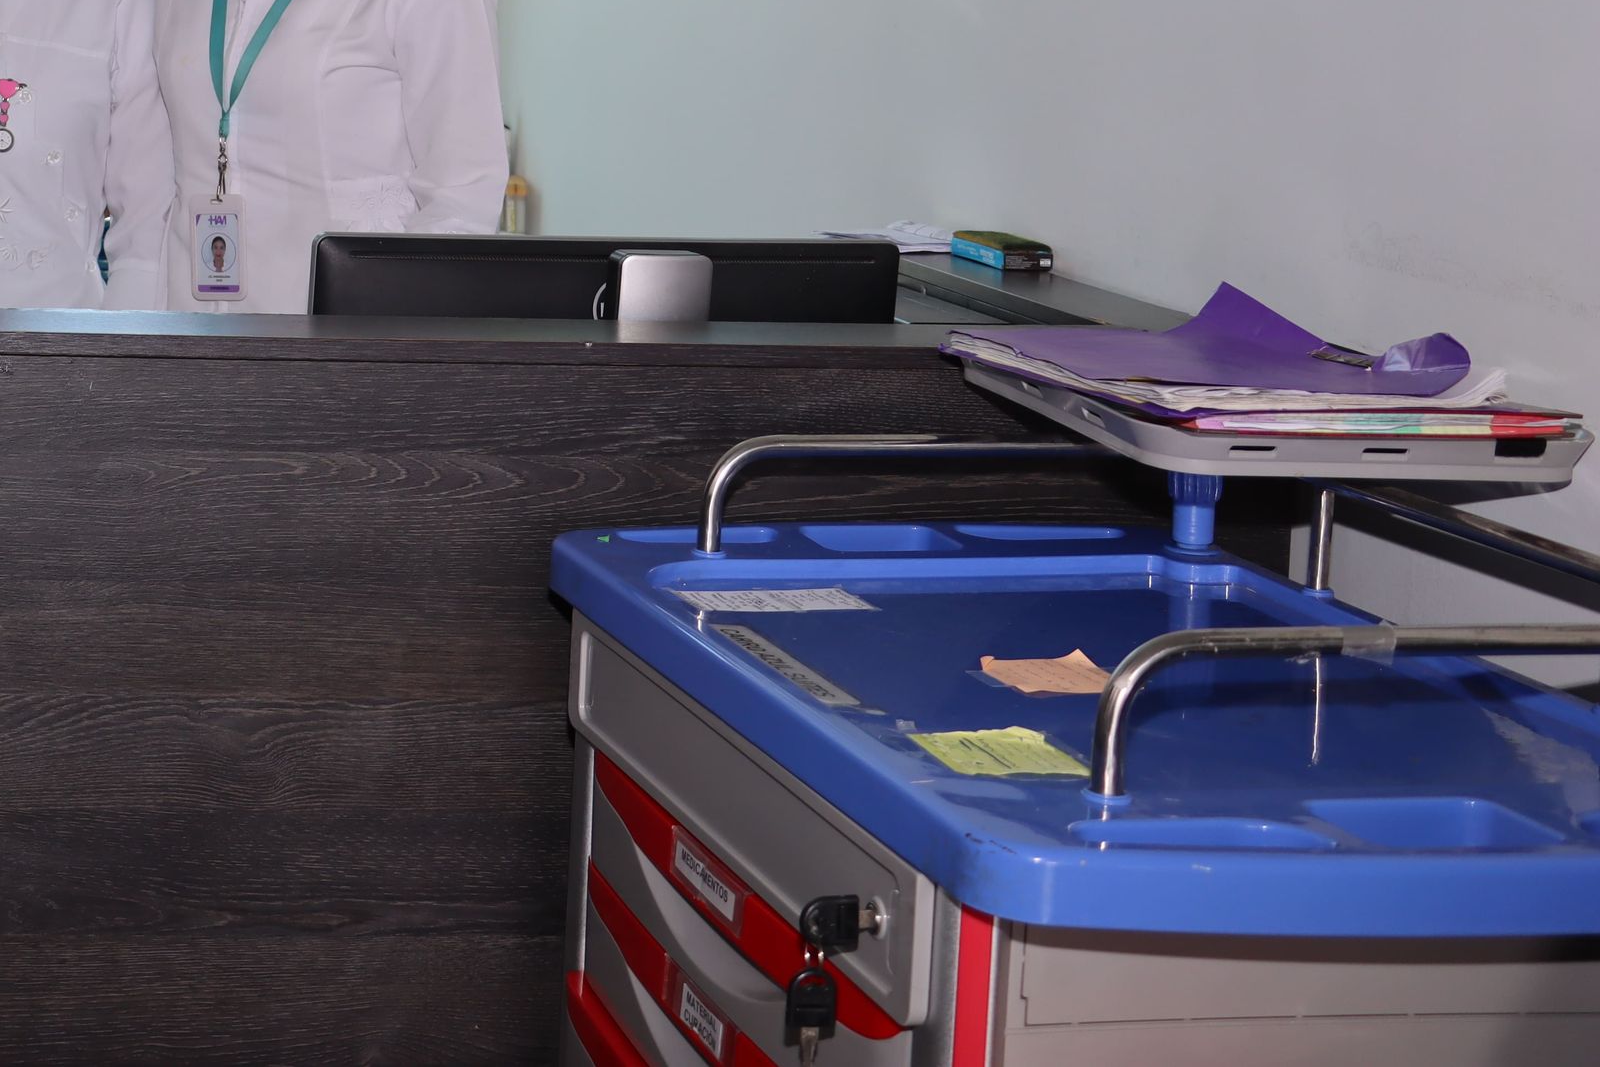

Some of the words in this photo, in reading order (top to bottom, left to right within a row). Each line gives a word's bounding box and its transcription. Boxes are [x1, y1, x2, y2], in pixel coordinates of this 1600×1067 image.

[681, 848, 729, 903] MEDICAMENTOS
[684, 1008, 717, 1052] CURACIÓN
[686, 990, 718, 1032] MATERIAL
